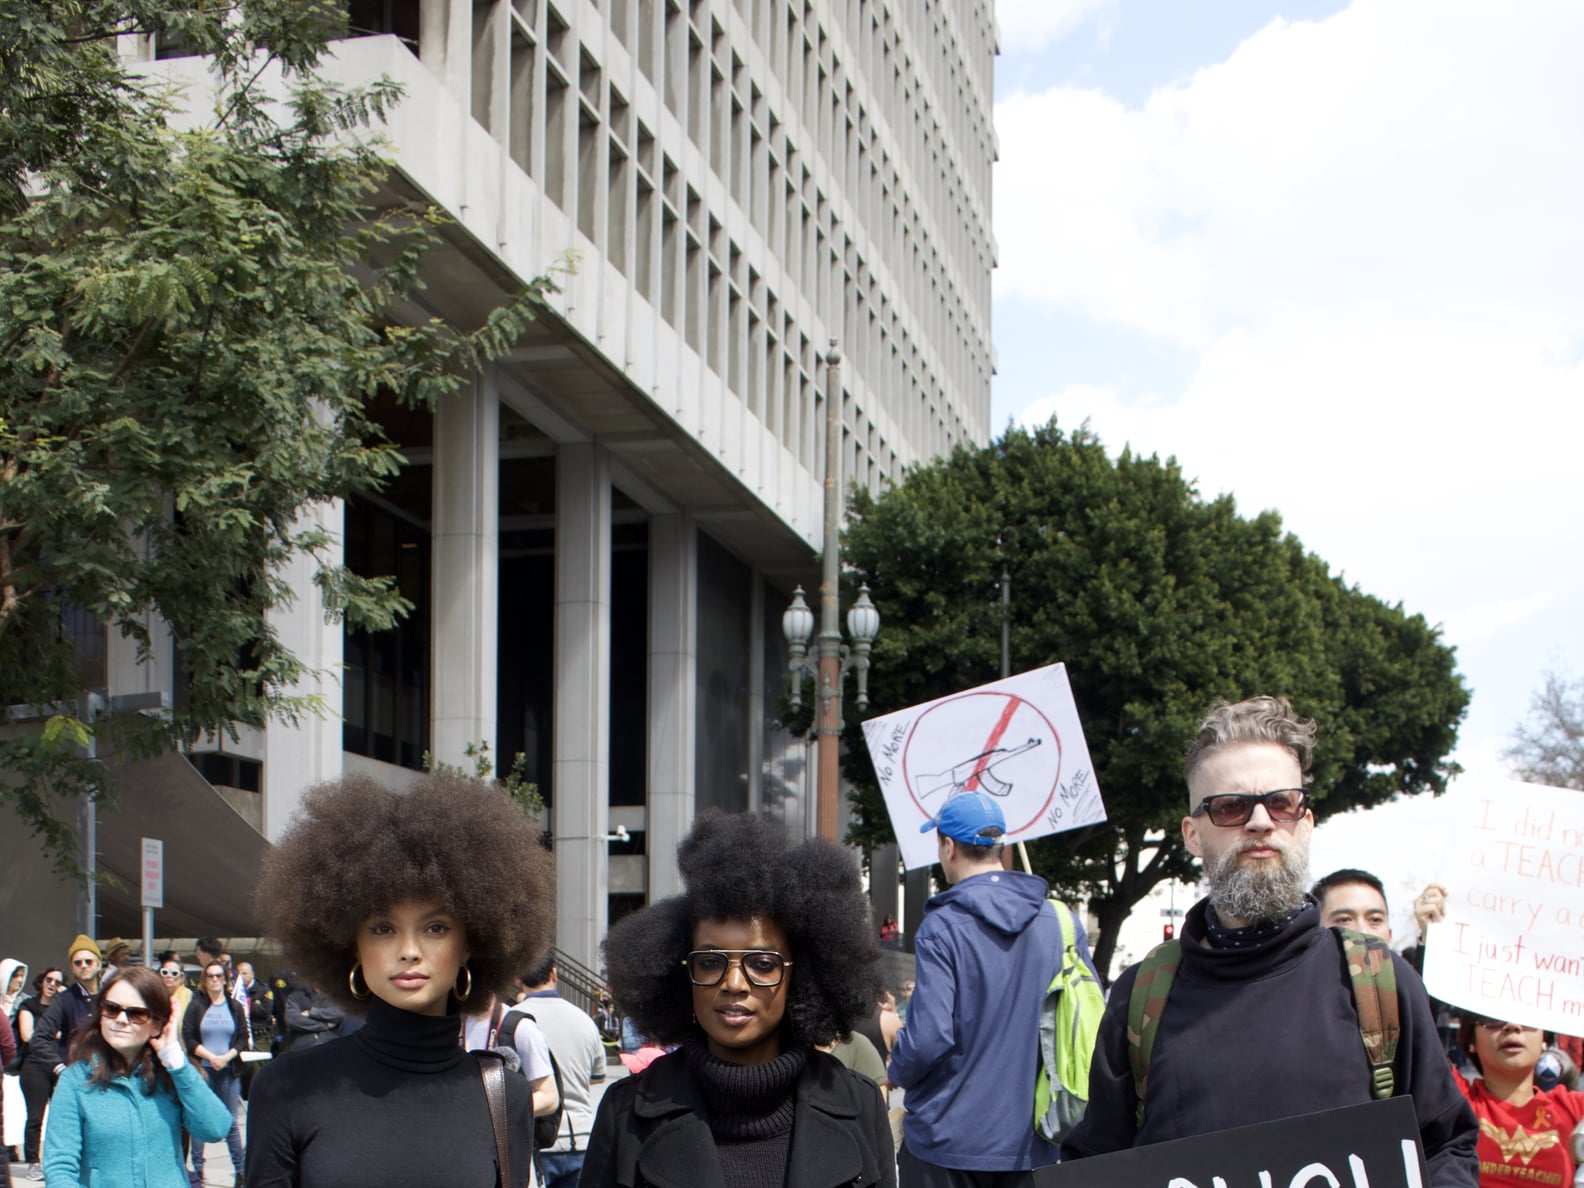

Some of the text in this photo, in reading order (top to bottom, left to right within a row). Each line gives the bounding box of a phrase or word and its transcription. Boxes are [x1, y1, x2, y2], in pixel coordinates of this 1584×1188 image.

[1474, 799, 1497, 831] I
[1514, 807, 1555, 841] did
[1470, 849, 1485, 867] a
[1467, 887, 1544, 932] carry
[1556, 906, 1571, 926] a
[1453, 922, 1471, 955] I
[1477, 934, 1525, 965] just
[1463, 962, 1584, 1017] TEACH m
